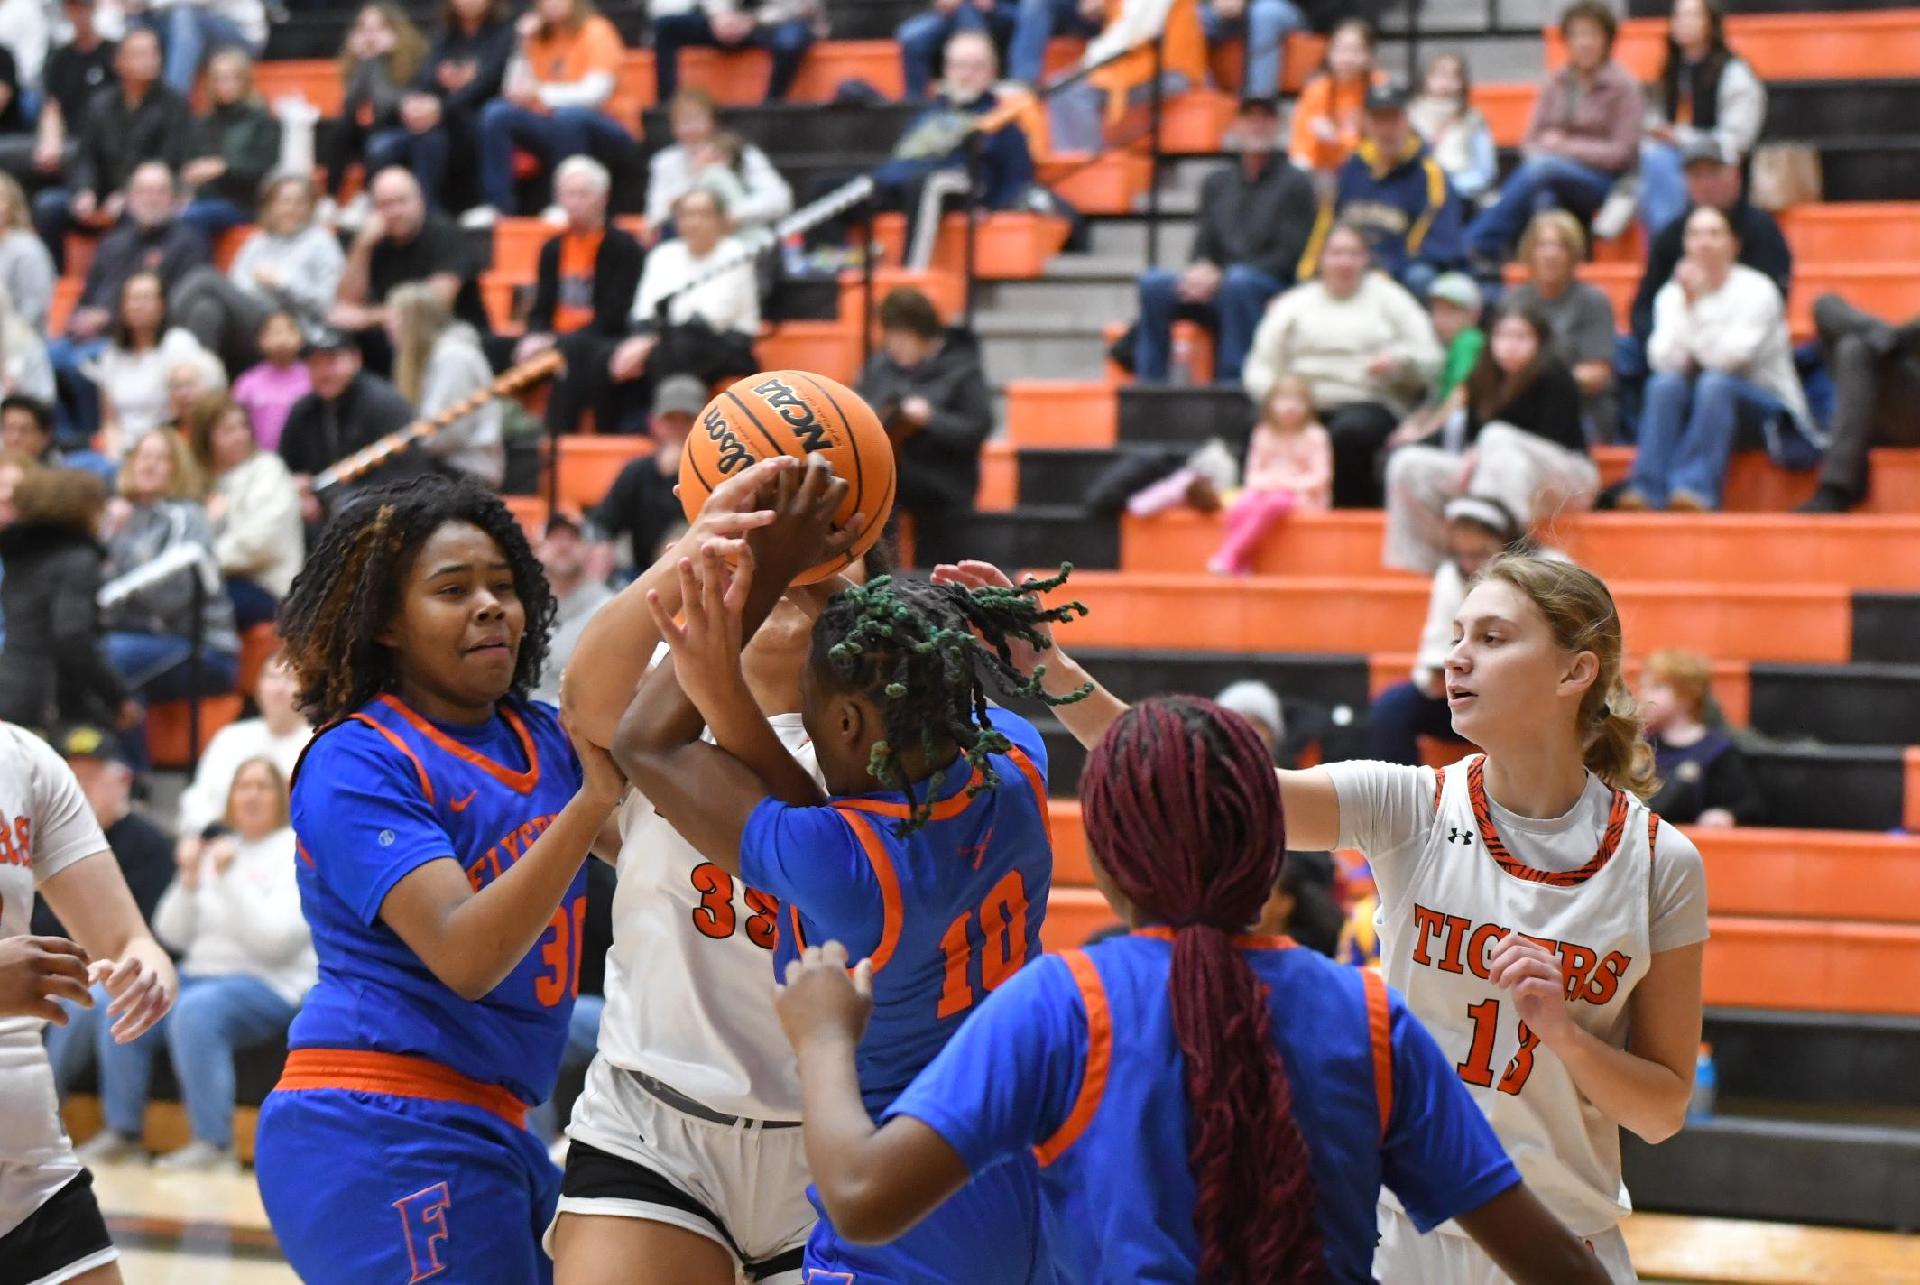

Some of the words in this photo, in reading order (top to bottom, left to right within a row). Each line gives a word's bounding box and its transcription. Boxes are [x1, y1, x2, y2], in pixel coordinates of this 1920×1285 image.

[753, 379, 833, 453] NCAA
[936, 868, 1029, 1020] 10
[1412, 903, 1631, 1005] TIGRS
[392, 1181, 451, 1285] F
